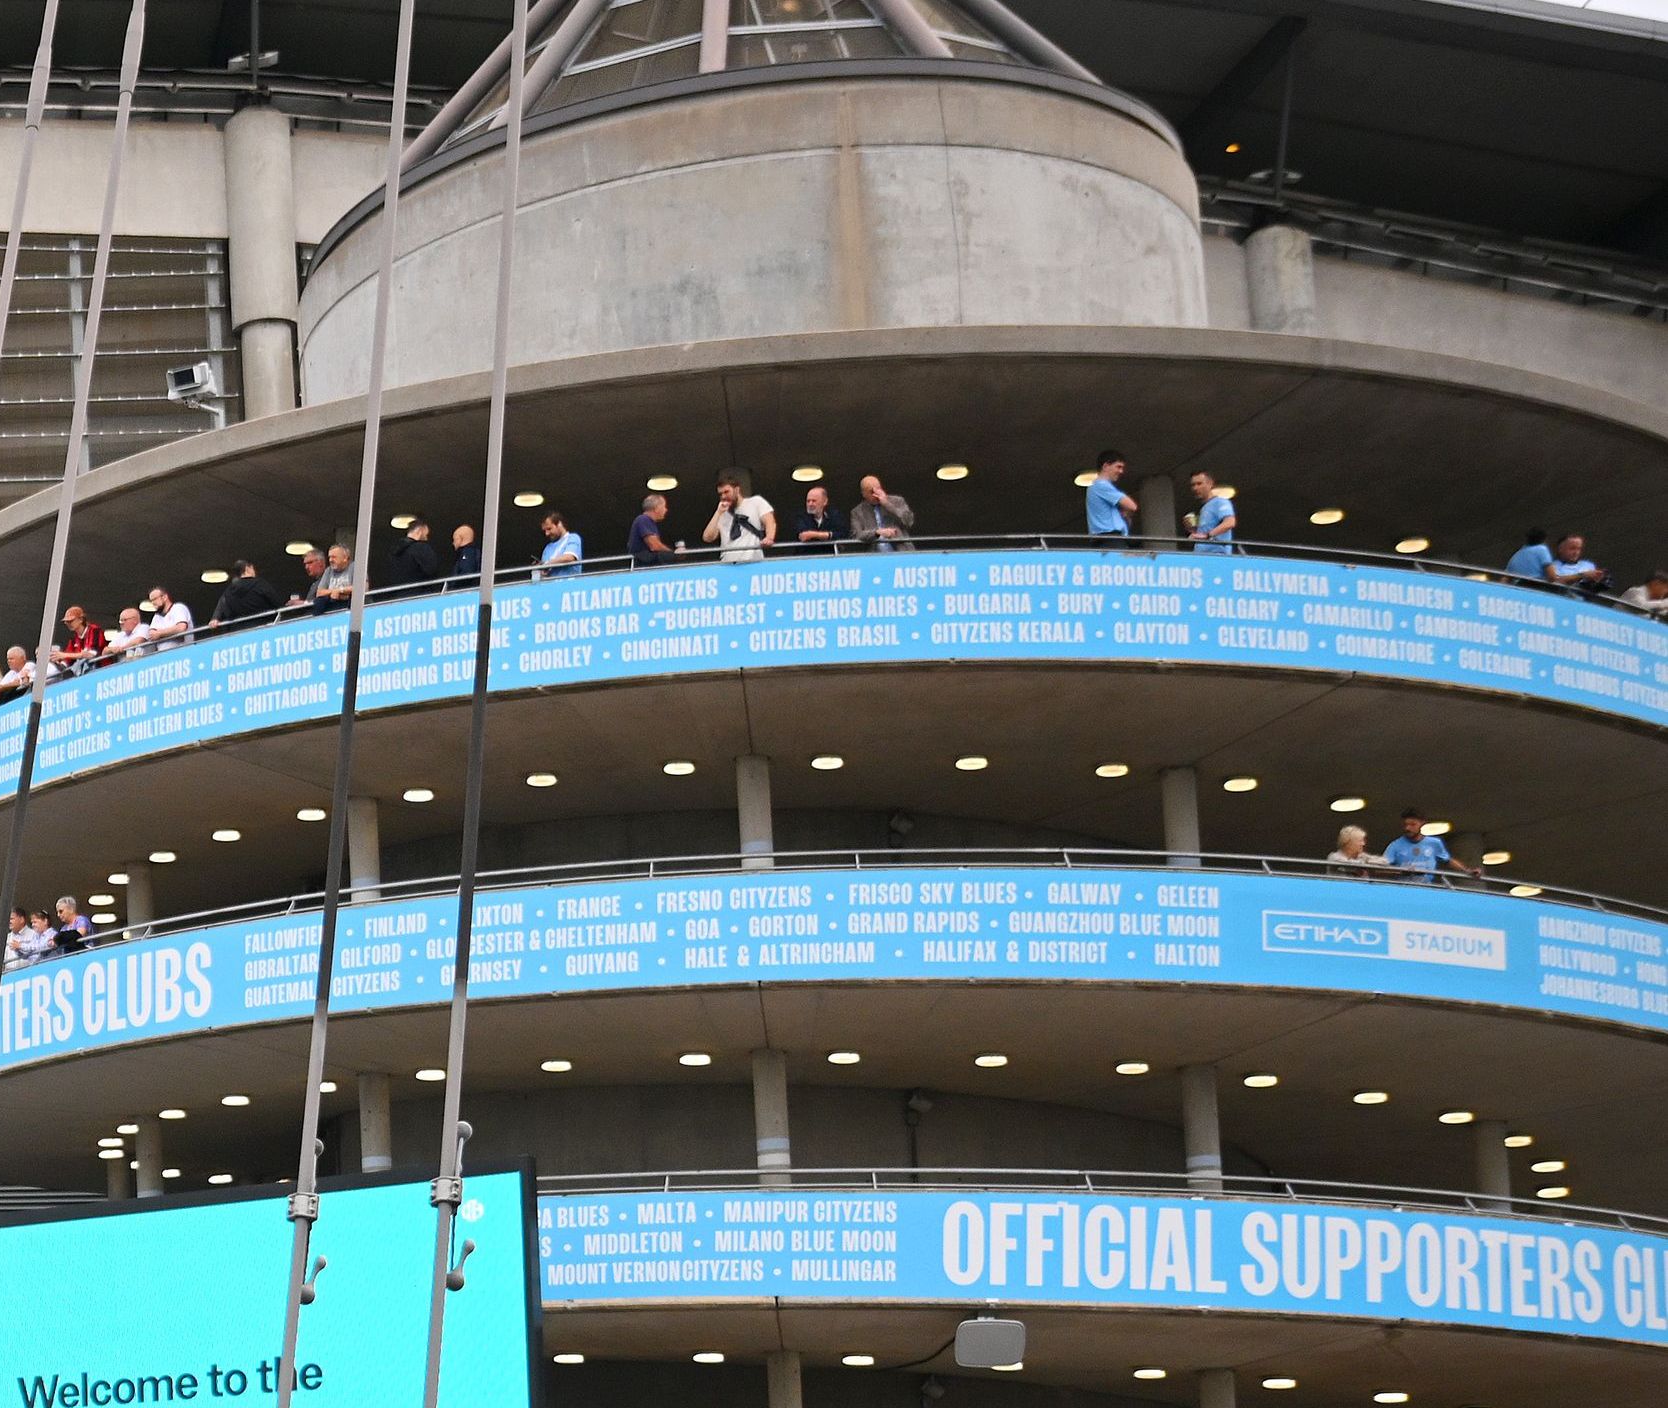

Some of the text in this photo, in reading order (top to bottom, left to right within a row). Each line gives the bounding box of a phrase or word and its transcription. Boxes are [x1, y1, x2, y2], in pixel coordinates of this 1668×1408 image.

[639, 565, 1066, 604] CITYZENS AUDENSHAW AUSTIN BAGULEY
[665, 594, 1102, 630] BUCHAREST BUENOS AIRES BULGARIA BURY
[622, 622, 1084, 661] CINCINNATI CITIZENS BRASIL CITYZENS KERALA
[658, 883, 1218, 912] FRESNO CITYZENS FRISCO SKY BLUES GALWAY GELEEN
[686, 912, 1218, 939] GOA GORTON GRAND RAPIDS GUANGZHOU BLUE MOON
[1273, 923, 1493, 956] ETIHAD STADIUM
[686, 941, 1219, 968] HALE ALTRINCHAM HALIFAX DISTRICT HALTON
[83, 942, 212, 1034] CLUBS
[558, 1201, 896, 1227] BLUES MALTA MANIPUR CITYZENS
[585, 1231, 896, 1254] MIDDLETON MILANO BLUE MOON
[792, 1260, 896, 1281] MULLINGAR
[943, 1201, 1603, 1322] OFFICIAL SUPPORTERS
[210, 1363, 248, 1397] to
